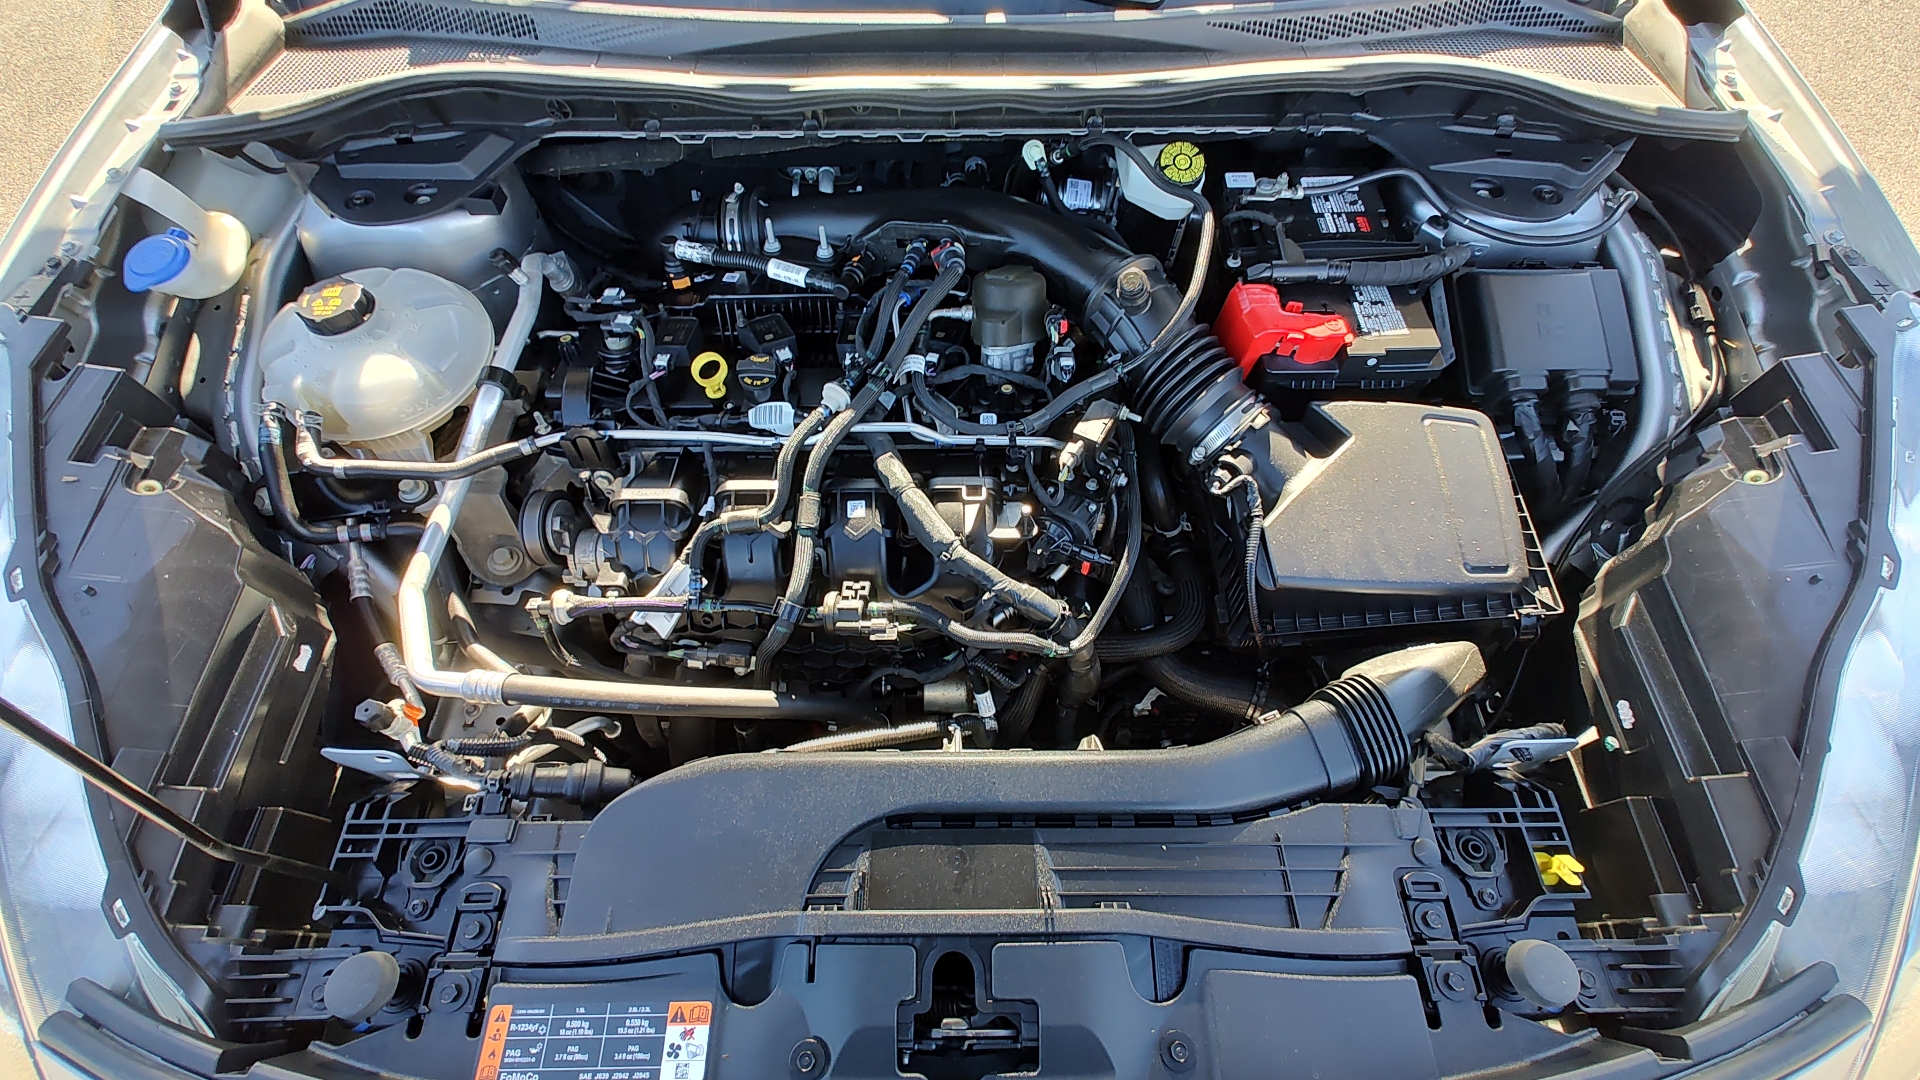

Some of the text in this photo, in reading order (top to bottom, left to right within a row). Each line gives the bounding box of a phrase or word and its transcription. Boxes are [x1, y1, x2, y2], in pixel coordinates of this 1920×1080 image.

[581, 1020, 590, 1029] kg
[640, 1019, 649, 1028] kg
[509, 1023, 538, 1033] R-1234yf
[505, 1049, 521, 1057] PAG
[567, 1045, 579, 1053] PAG
[500, 1072, 539, 1080] FoMoCo
